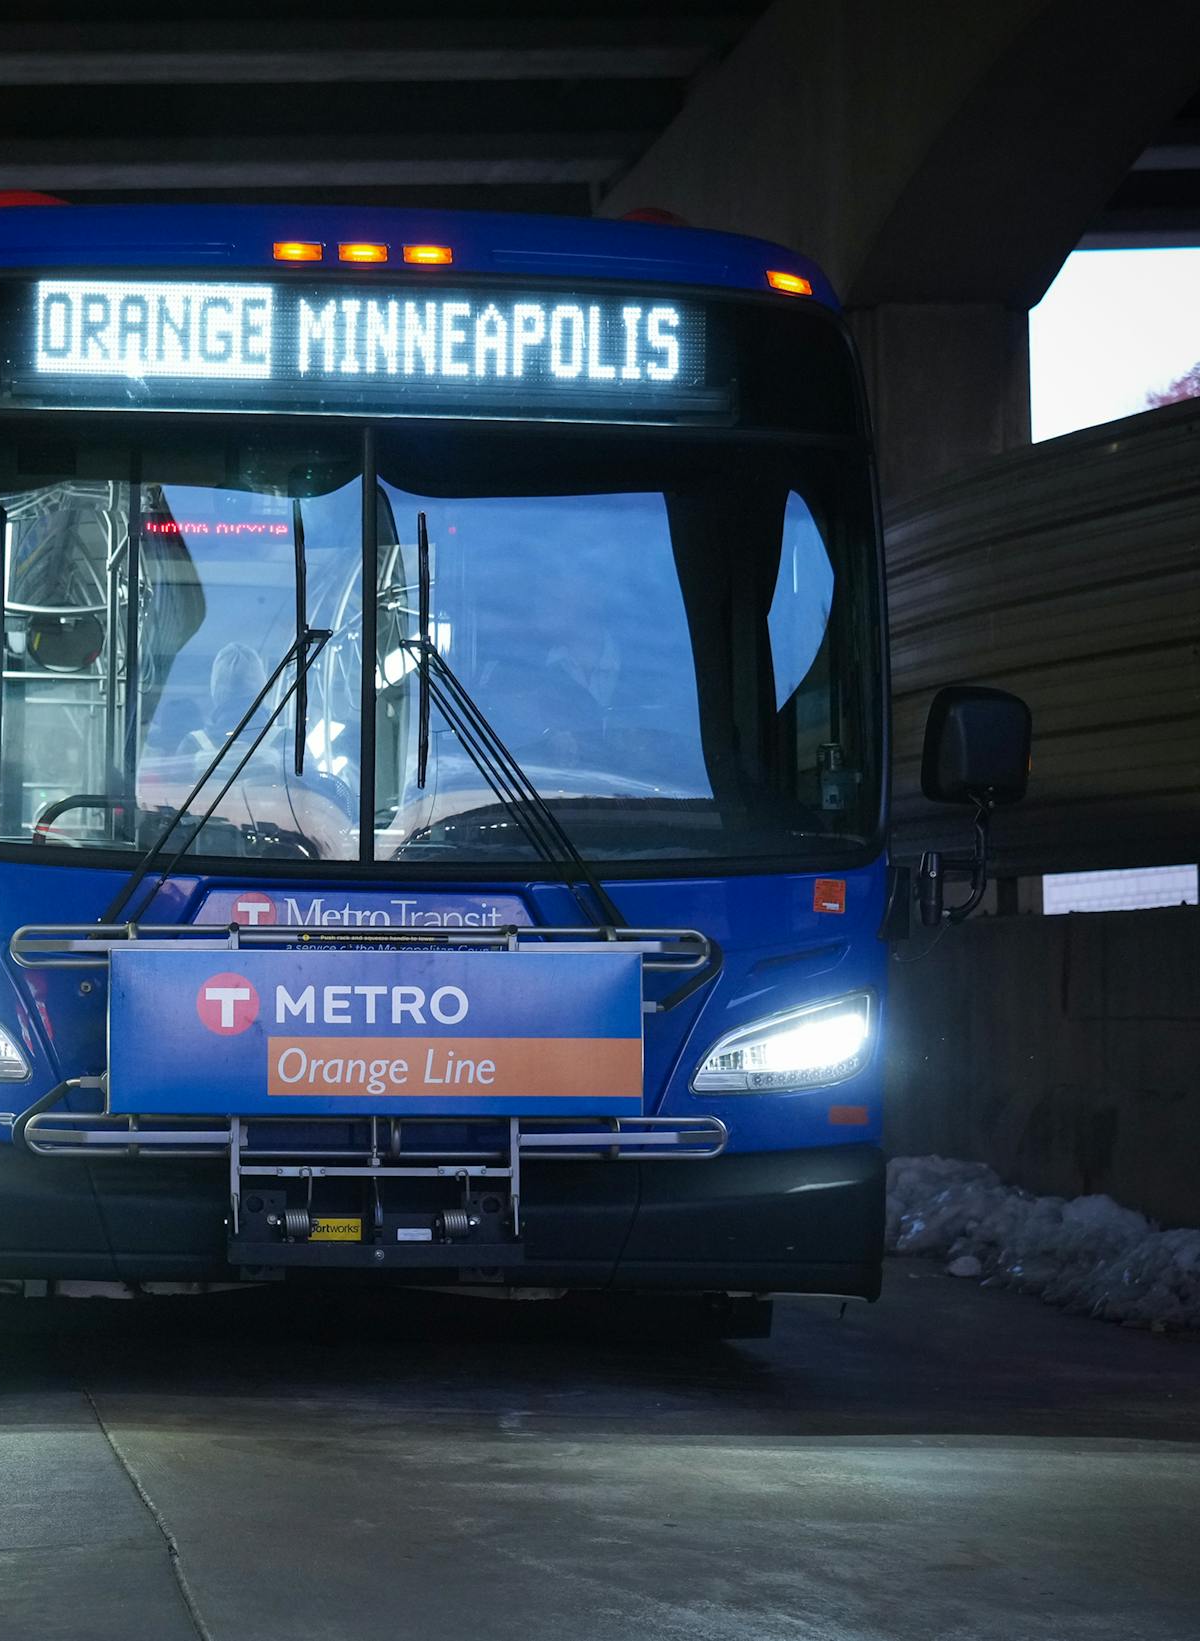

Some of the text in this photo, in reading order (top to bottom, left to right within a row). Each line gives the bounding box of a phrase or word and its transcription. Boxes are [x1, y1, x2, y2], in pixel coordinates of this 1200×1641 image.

[41, 292, 680, 380] ORANGE MINNEAPOLIS
[205, 984, 469, 1028] T METRO
[277, 1047, 496, 1095] Orange Line
